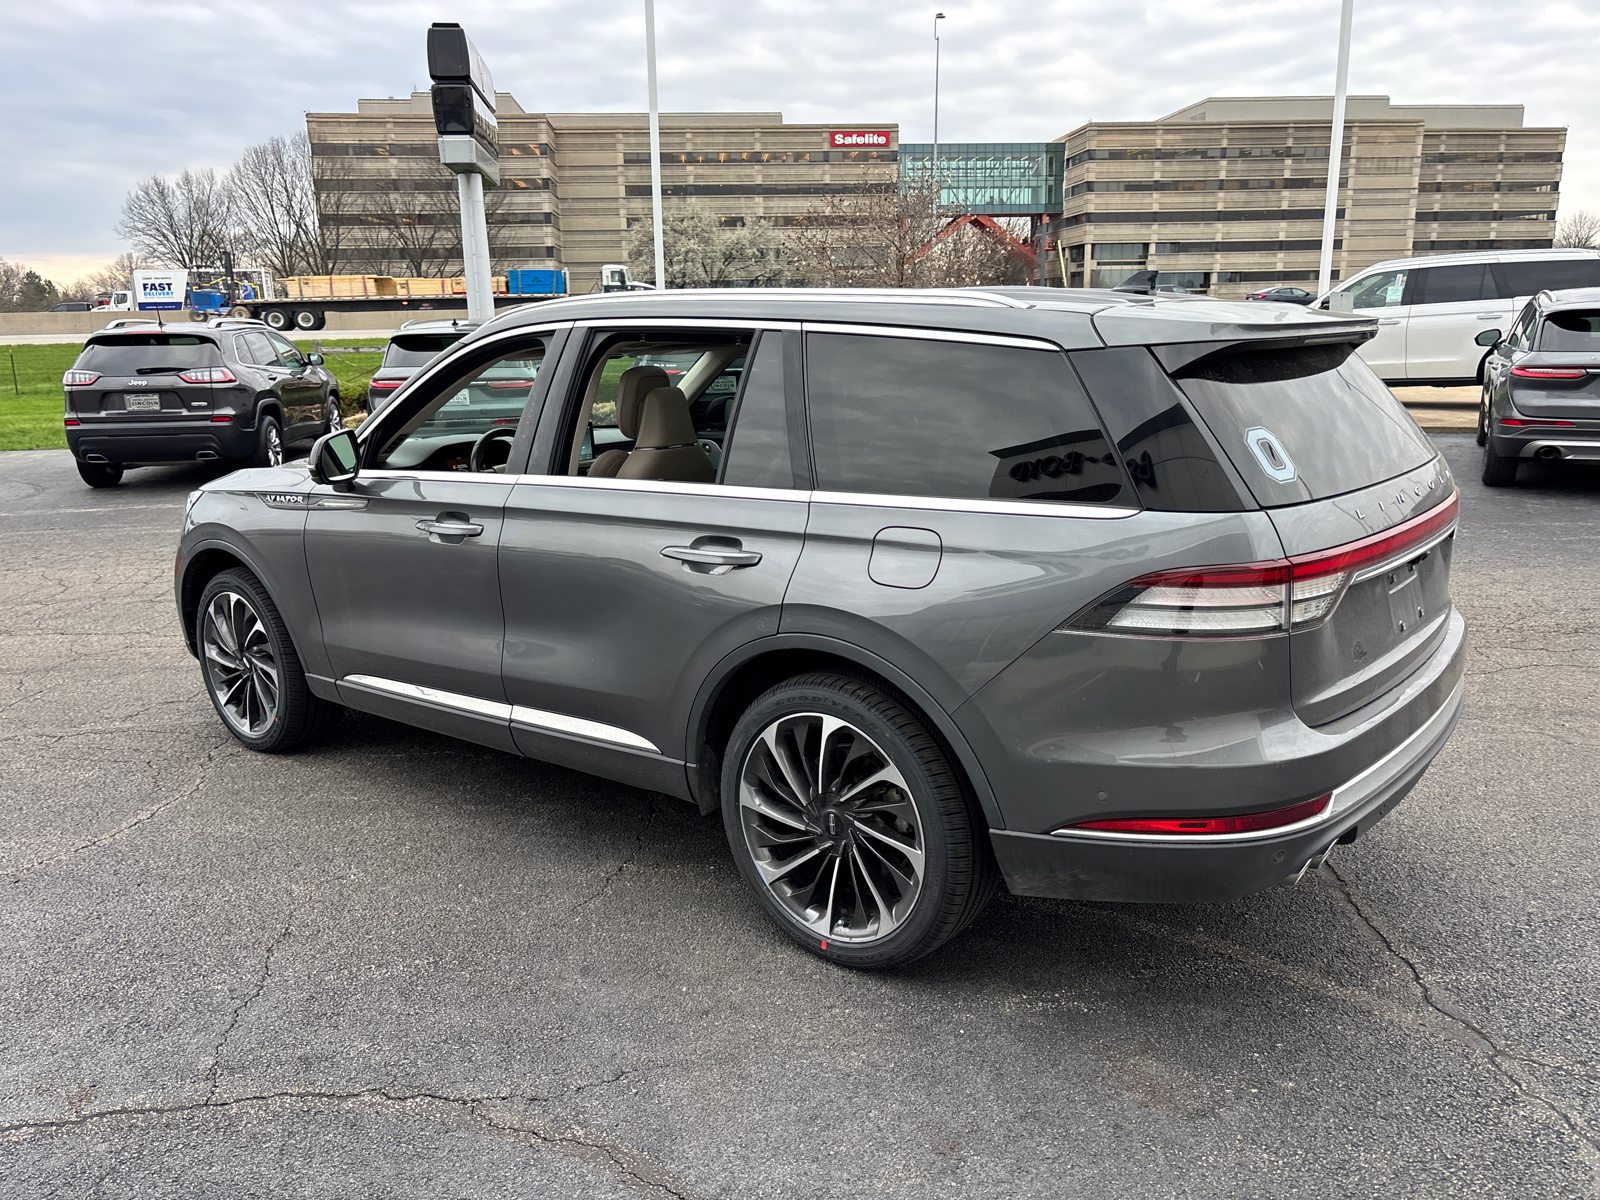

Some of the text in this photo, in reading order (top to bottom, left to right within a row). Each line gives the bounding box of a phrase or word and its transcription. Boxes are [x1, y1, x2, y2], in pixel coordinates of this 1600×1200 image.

[834, 133, 887, 145] Safelite
[142, 282, 173, 291] FAST
[127, 379, 148, 387] Jeep
[265, 494, 304, 504] AVIATOR
[1355, 469, 1451, 520] LINCOLN
